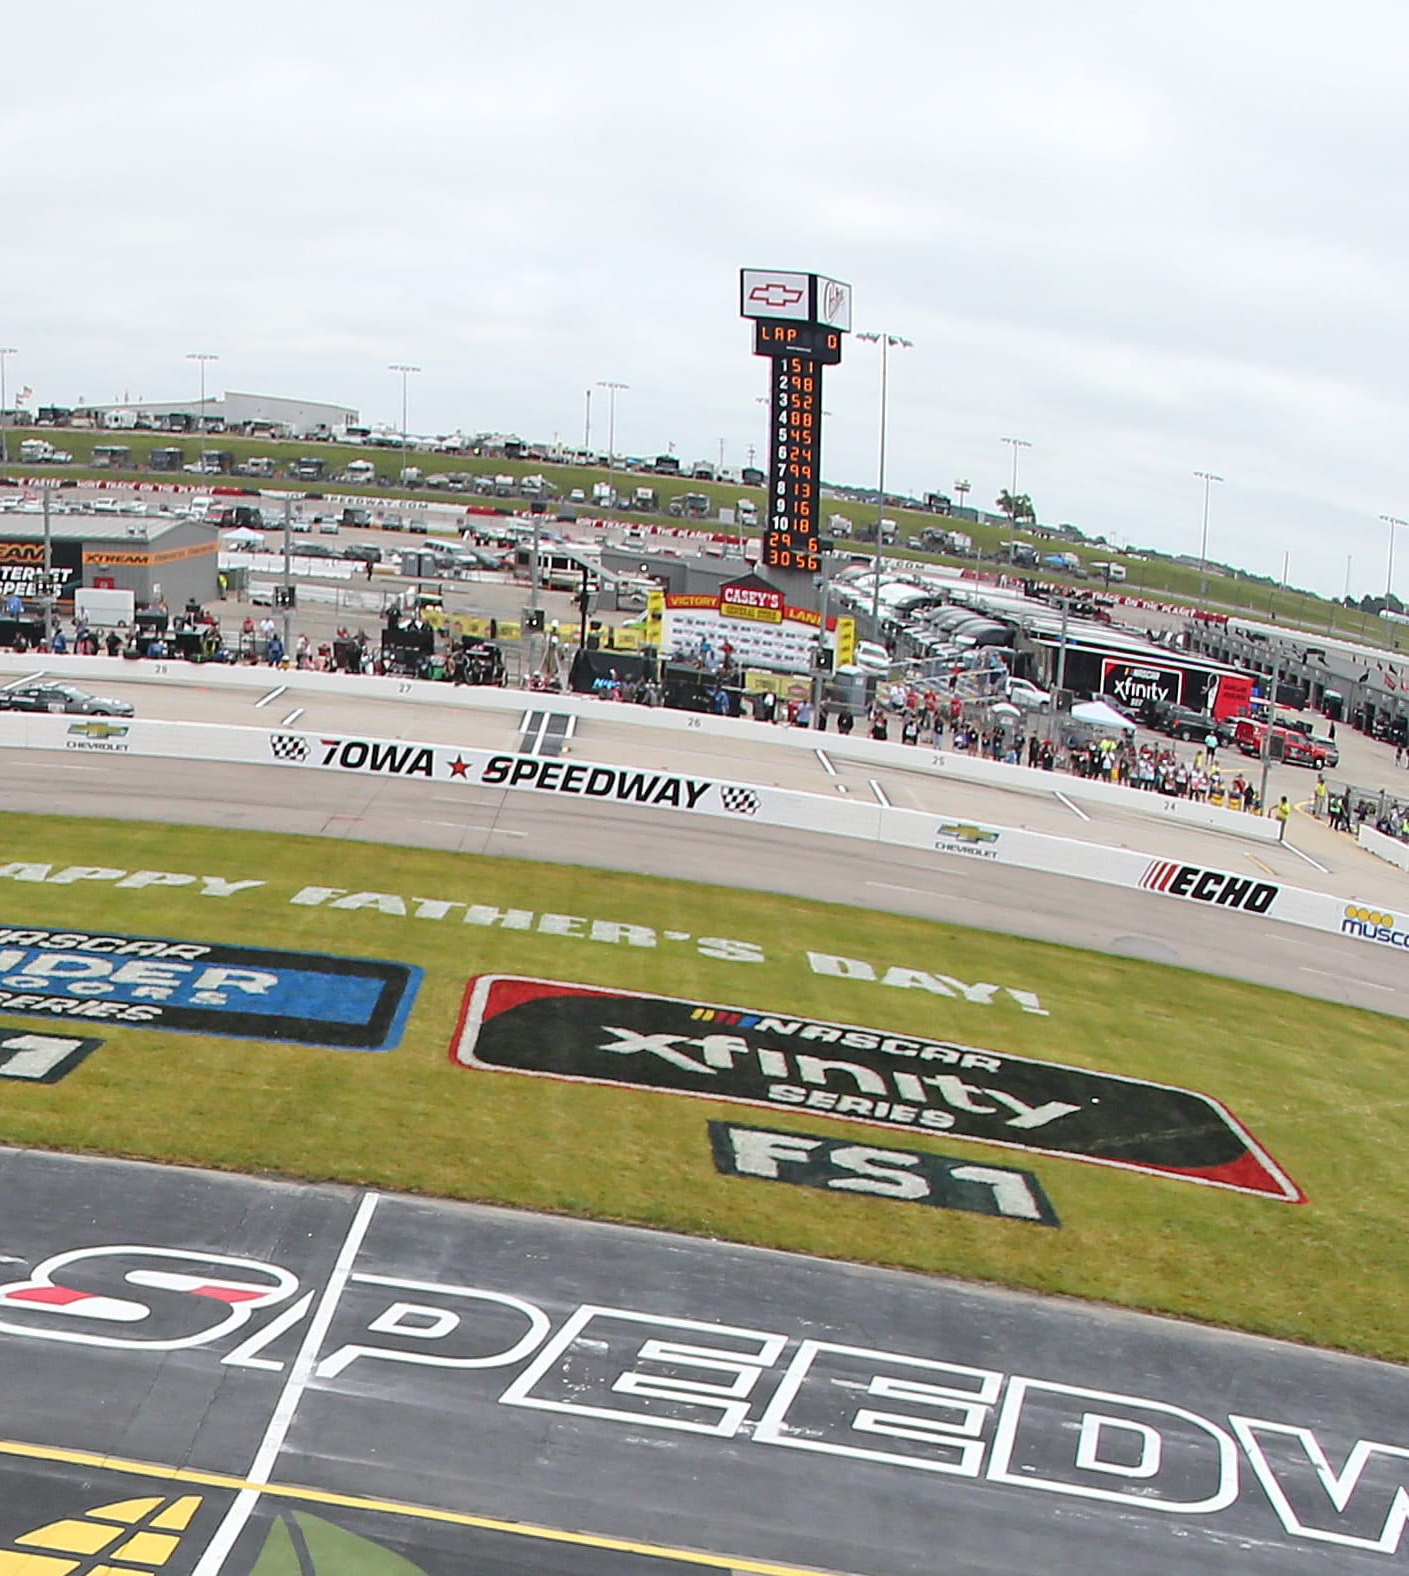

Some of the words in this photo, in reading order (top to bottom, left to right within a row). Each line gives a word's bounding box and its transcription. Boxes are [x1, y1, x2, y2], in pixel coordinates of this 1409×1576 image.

[762, 327, 797, 342] LAP
[827, 335, 837, 349] 0
[781, 359, 788, 372] 1
[792, 358, 813, 374] 51
[779, 376, 788, 389] 2
[791, 376, 813, 392] 98
[779, 393, 788, 407] 3
[791, 394, 813, 410] 52
[778, 411, 787, 425] 4
[791, 412, 813, 427] 88
[778, 428, 787, 442] 5
[791, 430, 812, 445] 45
[778, 446, 787, 460] 6
[790, 447, 811, 462] 24
[778, 463, 787, 477] 7
[789, 464, 811, 480] 99
[777, 481, 786, 495] 8
[794, 483, 810, 498] 13
[777, 499, 786, 513] 9
[793, 501, 810, 516] 16
[772, 516, 788, 530] 10
[793, 518, 809, 534] 18
[86, 553, 149, 563] XTREAM
[770, 550, 790, 567] 30
[670, 596, 717, 607] VICTORY
[724, 588, 779, 608] CASEY'S
[155, 664, 168, 674] 28
[399, 683, 412, 693] 27
[1114, 677, 1170, 701] xfinity
[687, 717, 701, 729] 26
[66, 741, 129, 752] CHEVROLET
[320, 738, 435, 777] IOWA
[482, 755, 712, 810] SPEEDWAY
[934, 841, 999, 860] CHEVROLET
[1170, 866, 1278, 914] ECHO
[290, 886, 766, 962] FATHER'S
[806, 951, 1051, 1016] DAY!
[749, 1016, 1003, 1074] NASCAR
[598, 1025, 1082, 1130] xfinity
[767, 1082, 956, 1129] SERIES
[725, 1125, 1043, 1221] FS1
